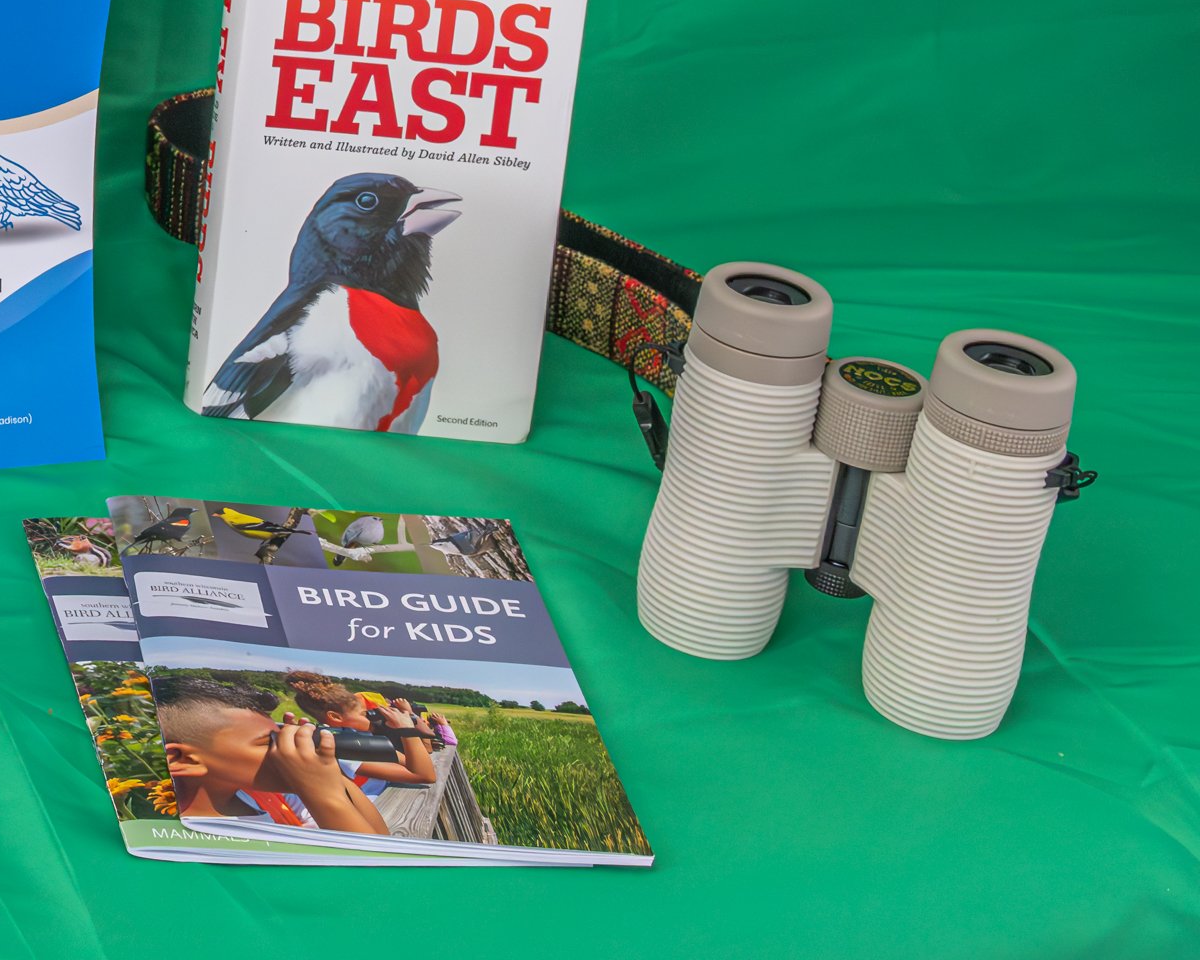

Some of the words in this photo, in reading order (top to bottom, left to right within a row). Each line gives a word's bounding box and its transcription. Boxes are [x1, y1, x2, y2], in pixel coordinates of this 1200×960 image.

[265, 55, 542, 149] EAST
[264, 135, 306, 148] Written
[310, 140, 332, 151] and
[336, 141, 398, 157] Illustrated
[401, 147, 416, 160] by
[418, 149, 455, 162] David
[457, 153, 490, 165] Allen
[493, 156, 532, 171] Sibley
[437, 414, 468, 425] Second
[469, 417, 498, 428] Edition
[150, 585, 179, 593] BIRD
[182, 589, 245, 600] ALLIANCE
[297, 586, 390, 609] BIRD
[400, 593, 527, 618] GUIDE
[64, 610, 101, 618] BIRD
[348, 618, 395, 642] for
[405, 622, 497, 645] KIDS
